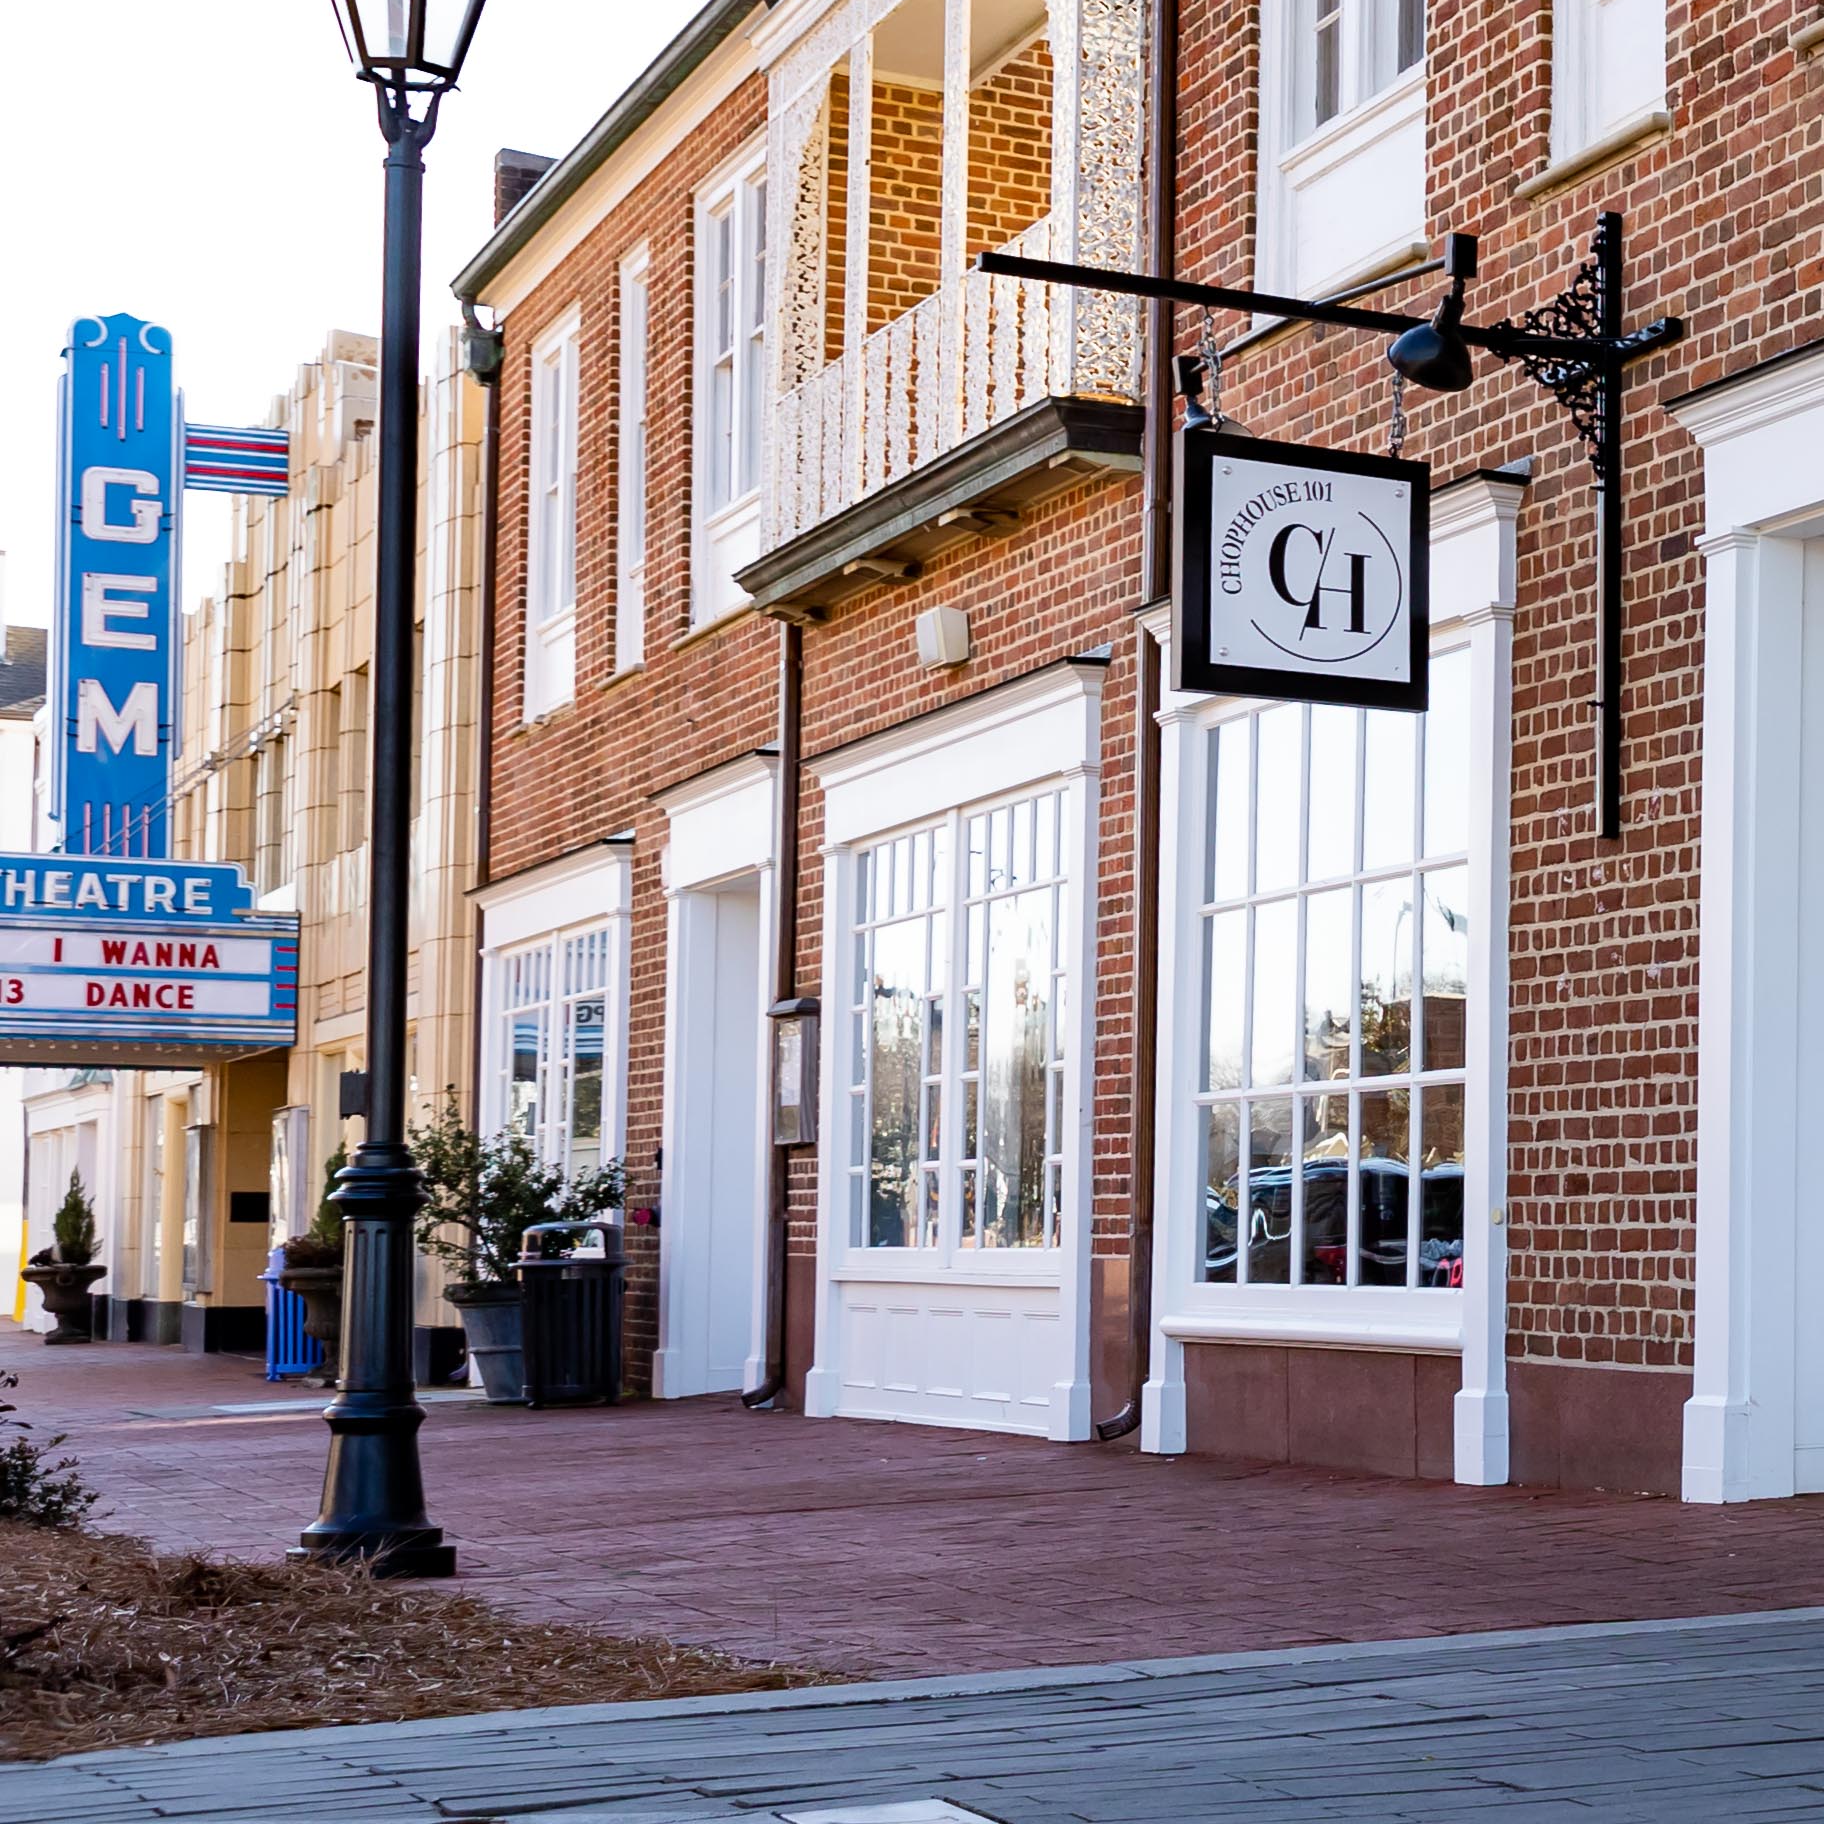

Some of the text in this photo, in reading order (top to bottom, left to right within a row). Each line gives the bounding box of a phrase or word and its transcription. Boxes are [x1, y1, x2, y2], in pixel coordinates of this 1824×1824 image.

[1220, 481, 1334, 595] CHOPHOUSE 101
[77, 466, 163, 757] GEM
[0, 868, 213, 916] HEATRE
[53, 938, 220, 969] I WANNA
[0, 978, 195, 1010] 3 DANCE
